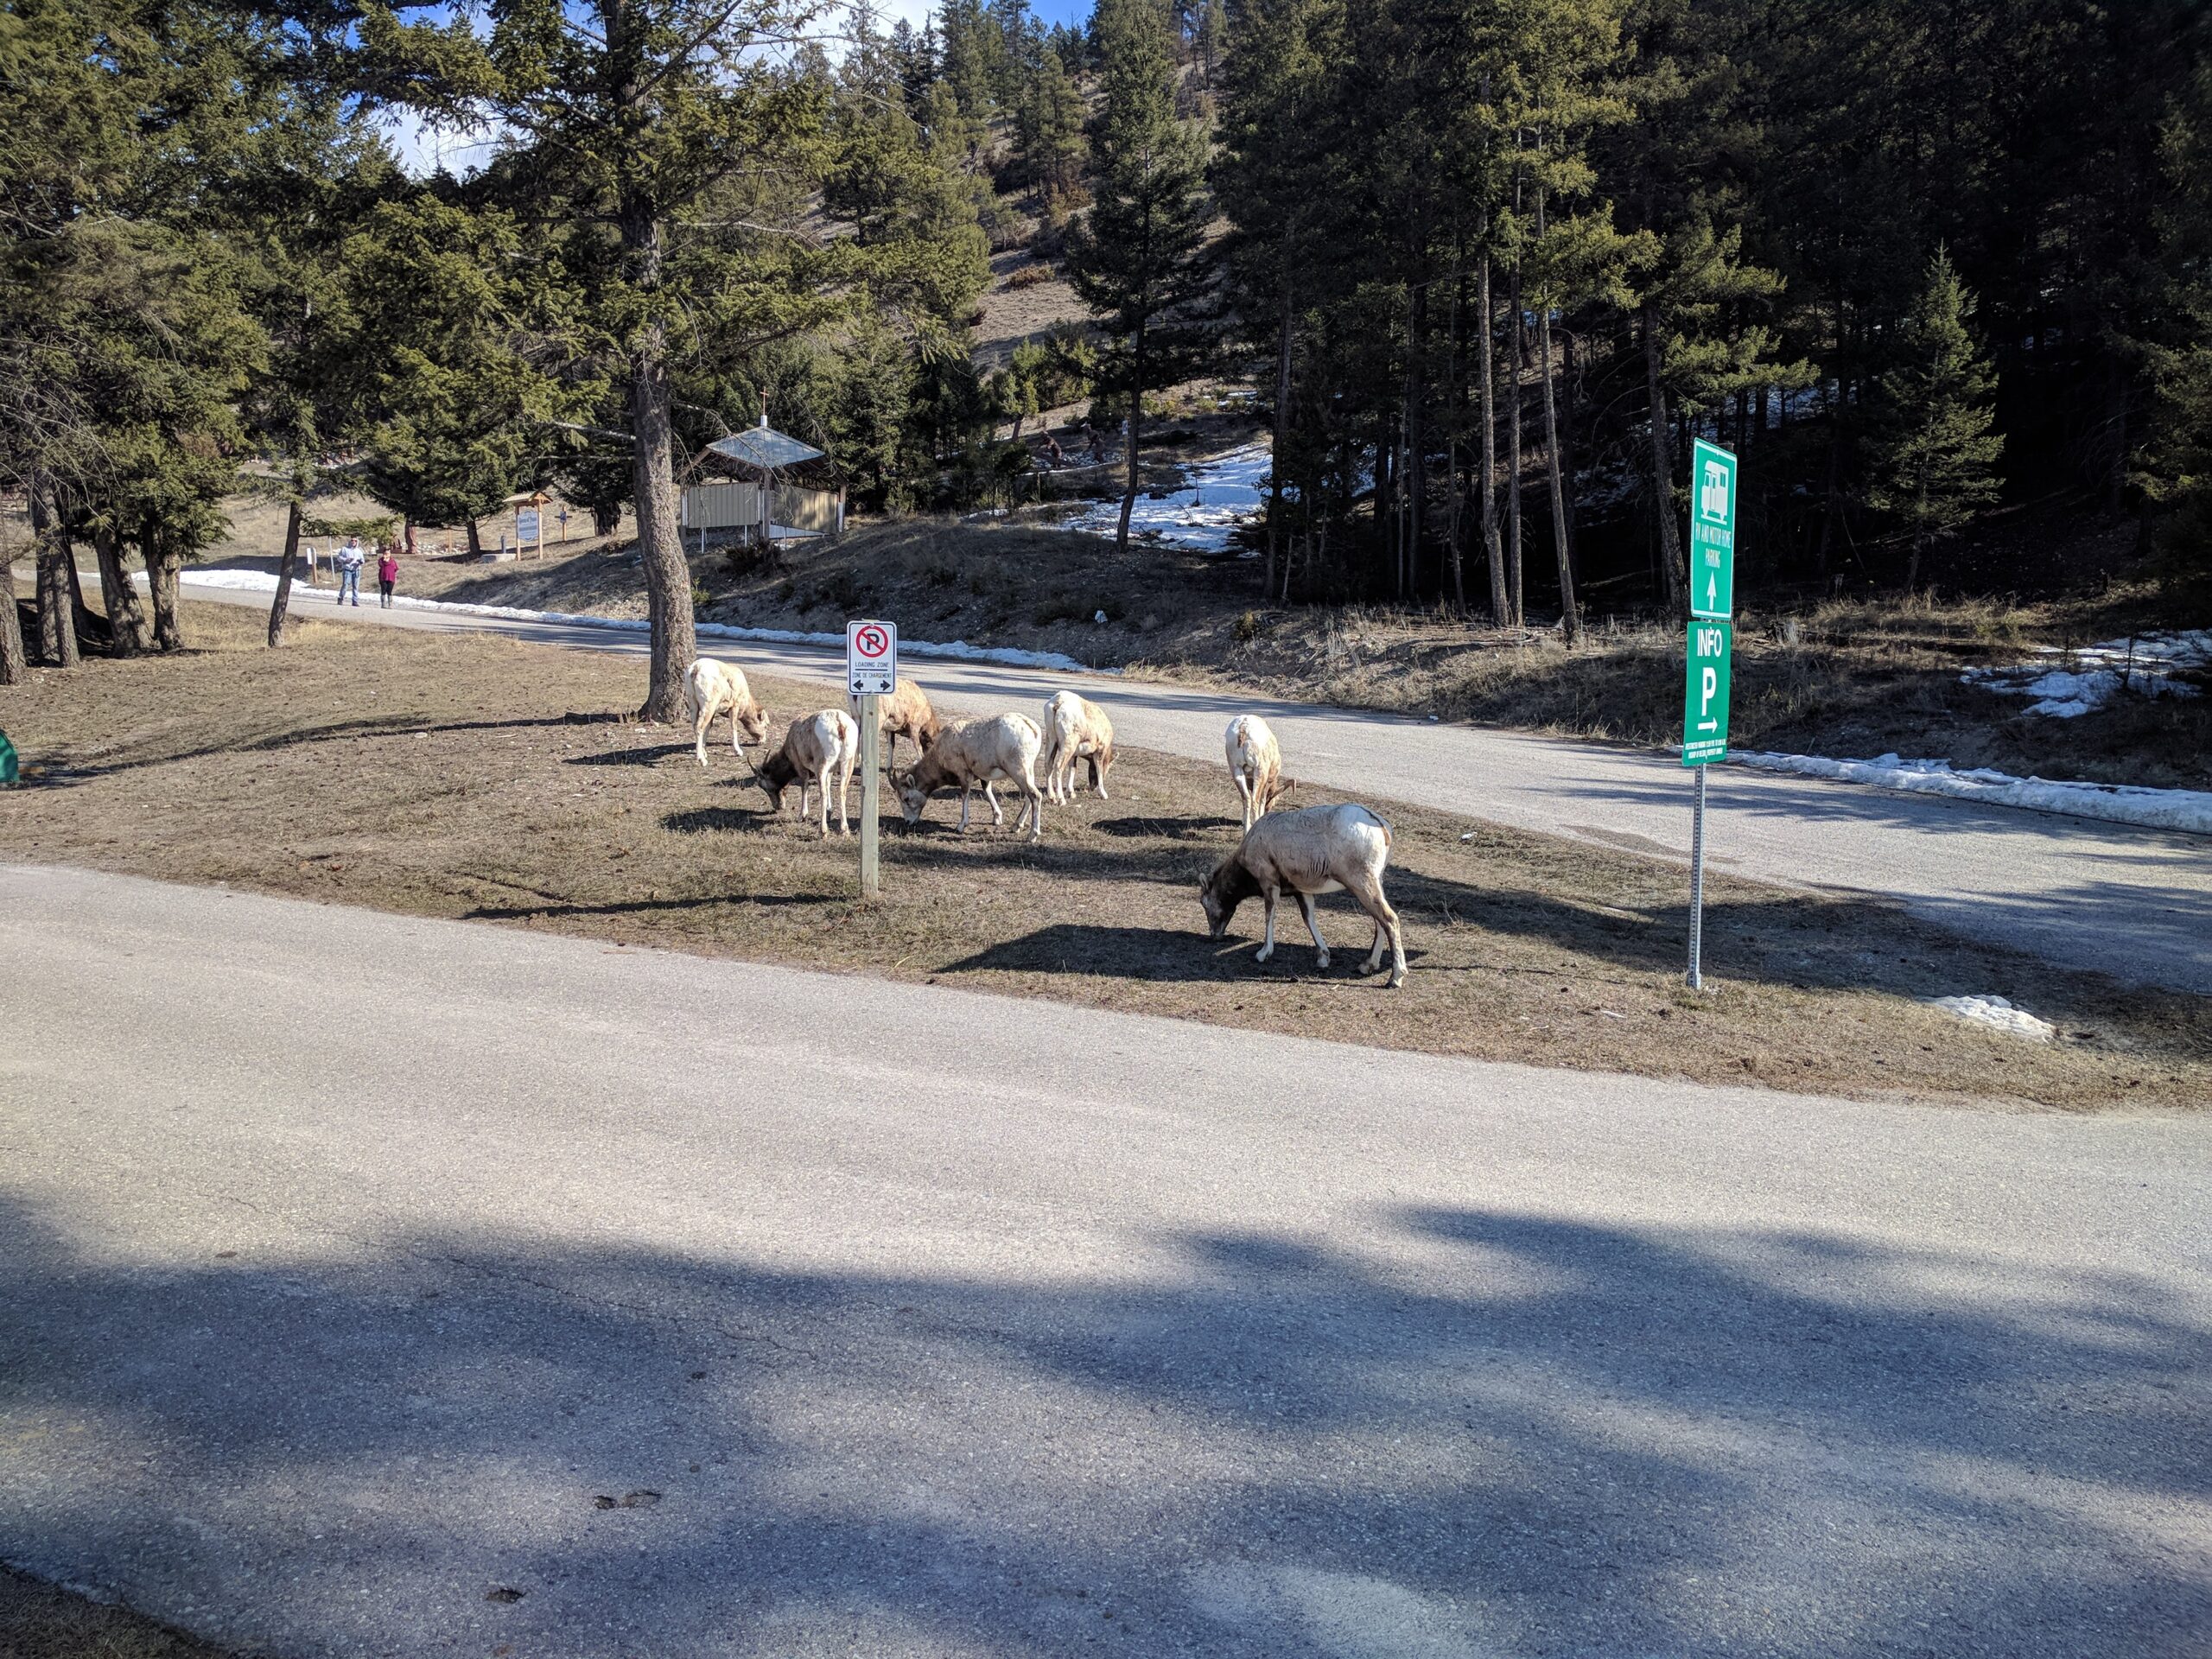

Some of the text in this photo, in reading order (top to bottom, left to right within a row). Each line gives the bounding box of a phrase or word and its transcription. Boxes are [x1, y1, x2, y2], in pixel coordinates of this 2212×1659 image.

[867, 633, 880, 651] P
[1697, 627, 1723, 658] INFO
[1701, 667, 1717, 716] P
